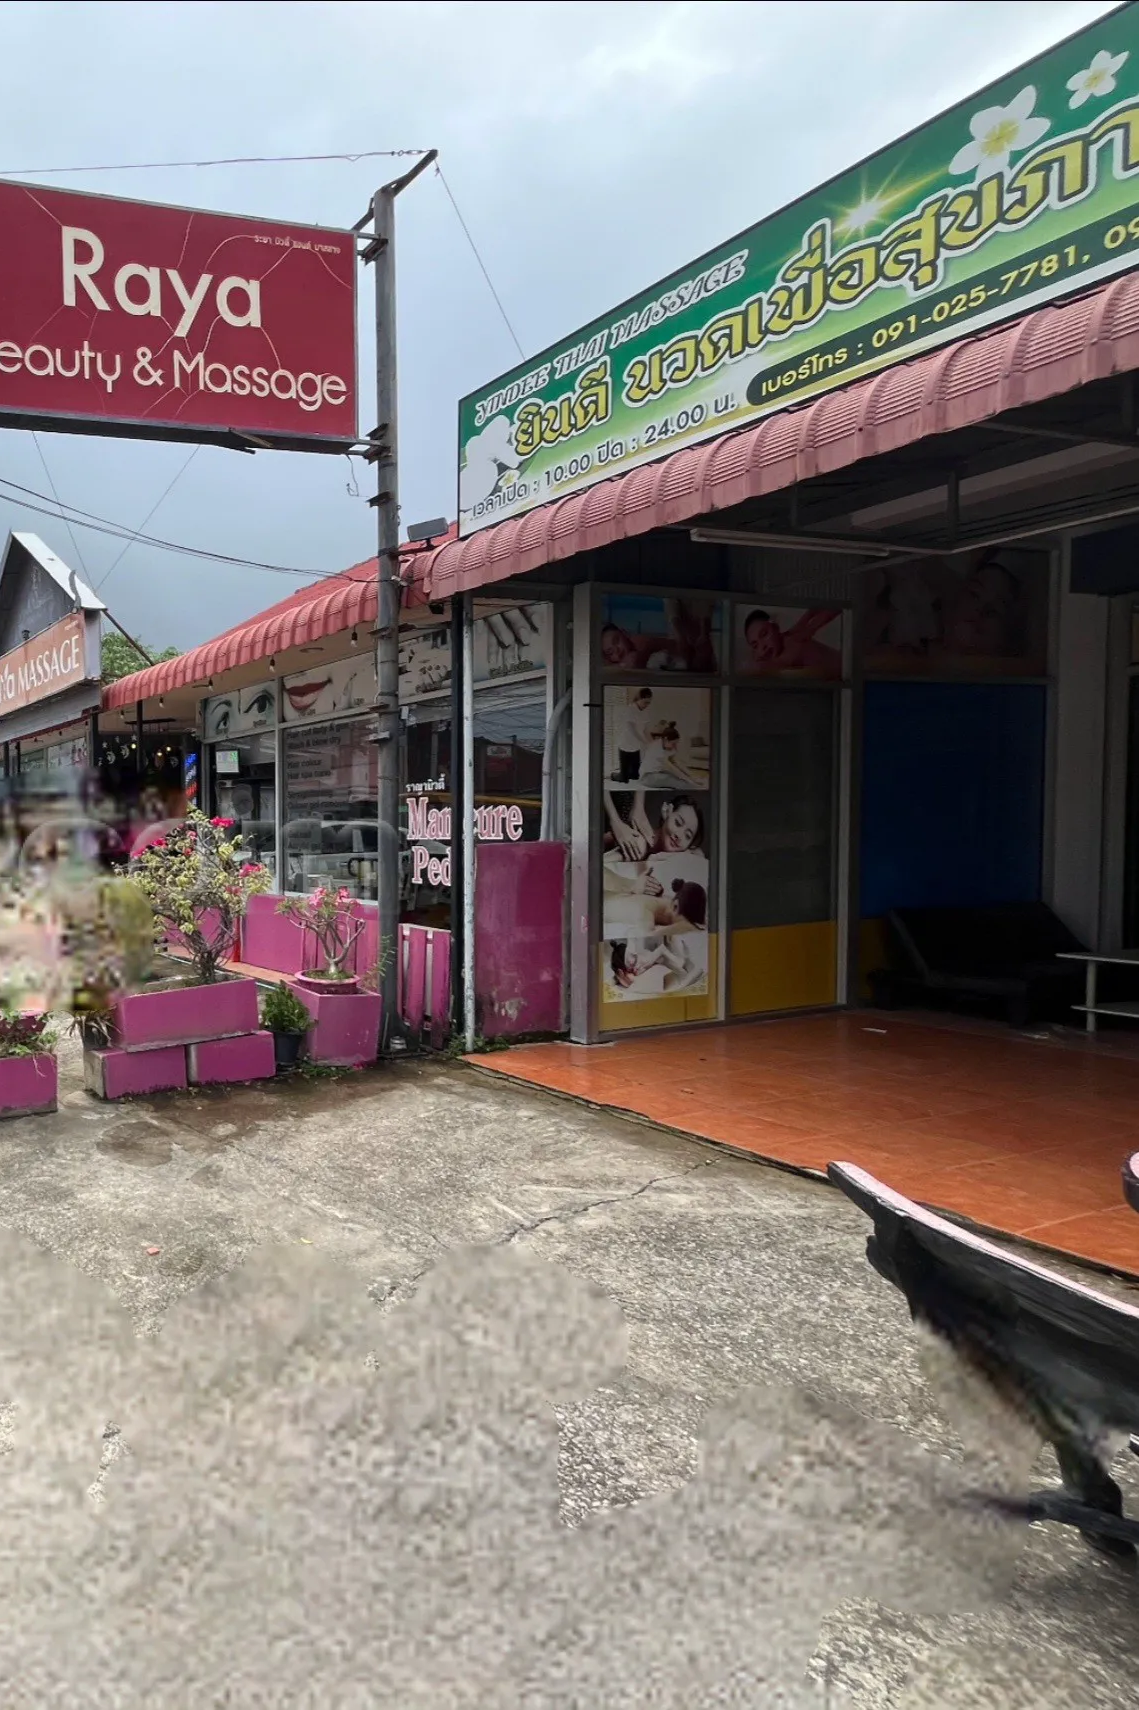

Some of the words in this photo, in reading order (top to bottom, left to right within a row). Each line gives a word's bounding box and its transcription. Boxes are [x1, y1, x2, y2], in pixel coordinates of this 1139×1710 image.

[62, 225, 261, 337] Raya
[475, 361, 552, 425] YINDEE
[554, 329, 609, 379] THAI
[611, 249, 749, 349] MASSAGE
[761, 352, 848, 398] เบอร์โทร
[132, 346, 165, 386] &
[173, 349, 348, 411] Massage
[514, 356, 611, 456] ยินดี
[544, 453, 591, 486] 10.00
[596, 436, 625, 464] ปิด
[644, 404, 706, 445] 24.00
[18, 634, 80, 694] MASSAGE
